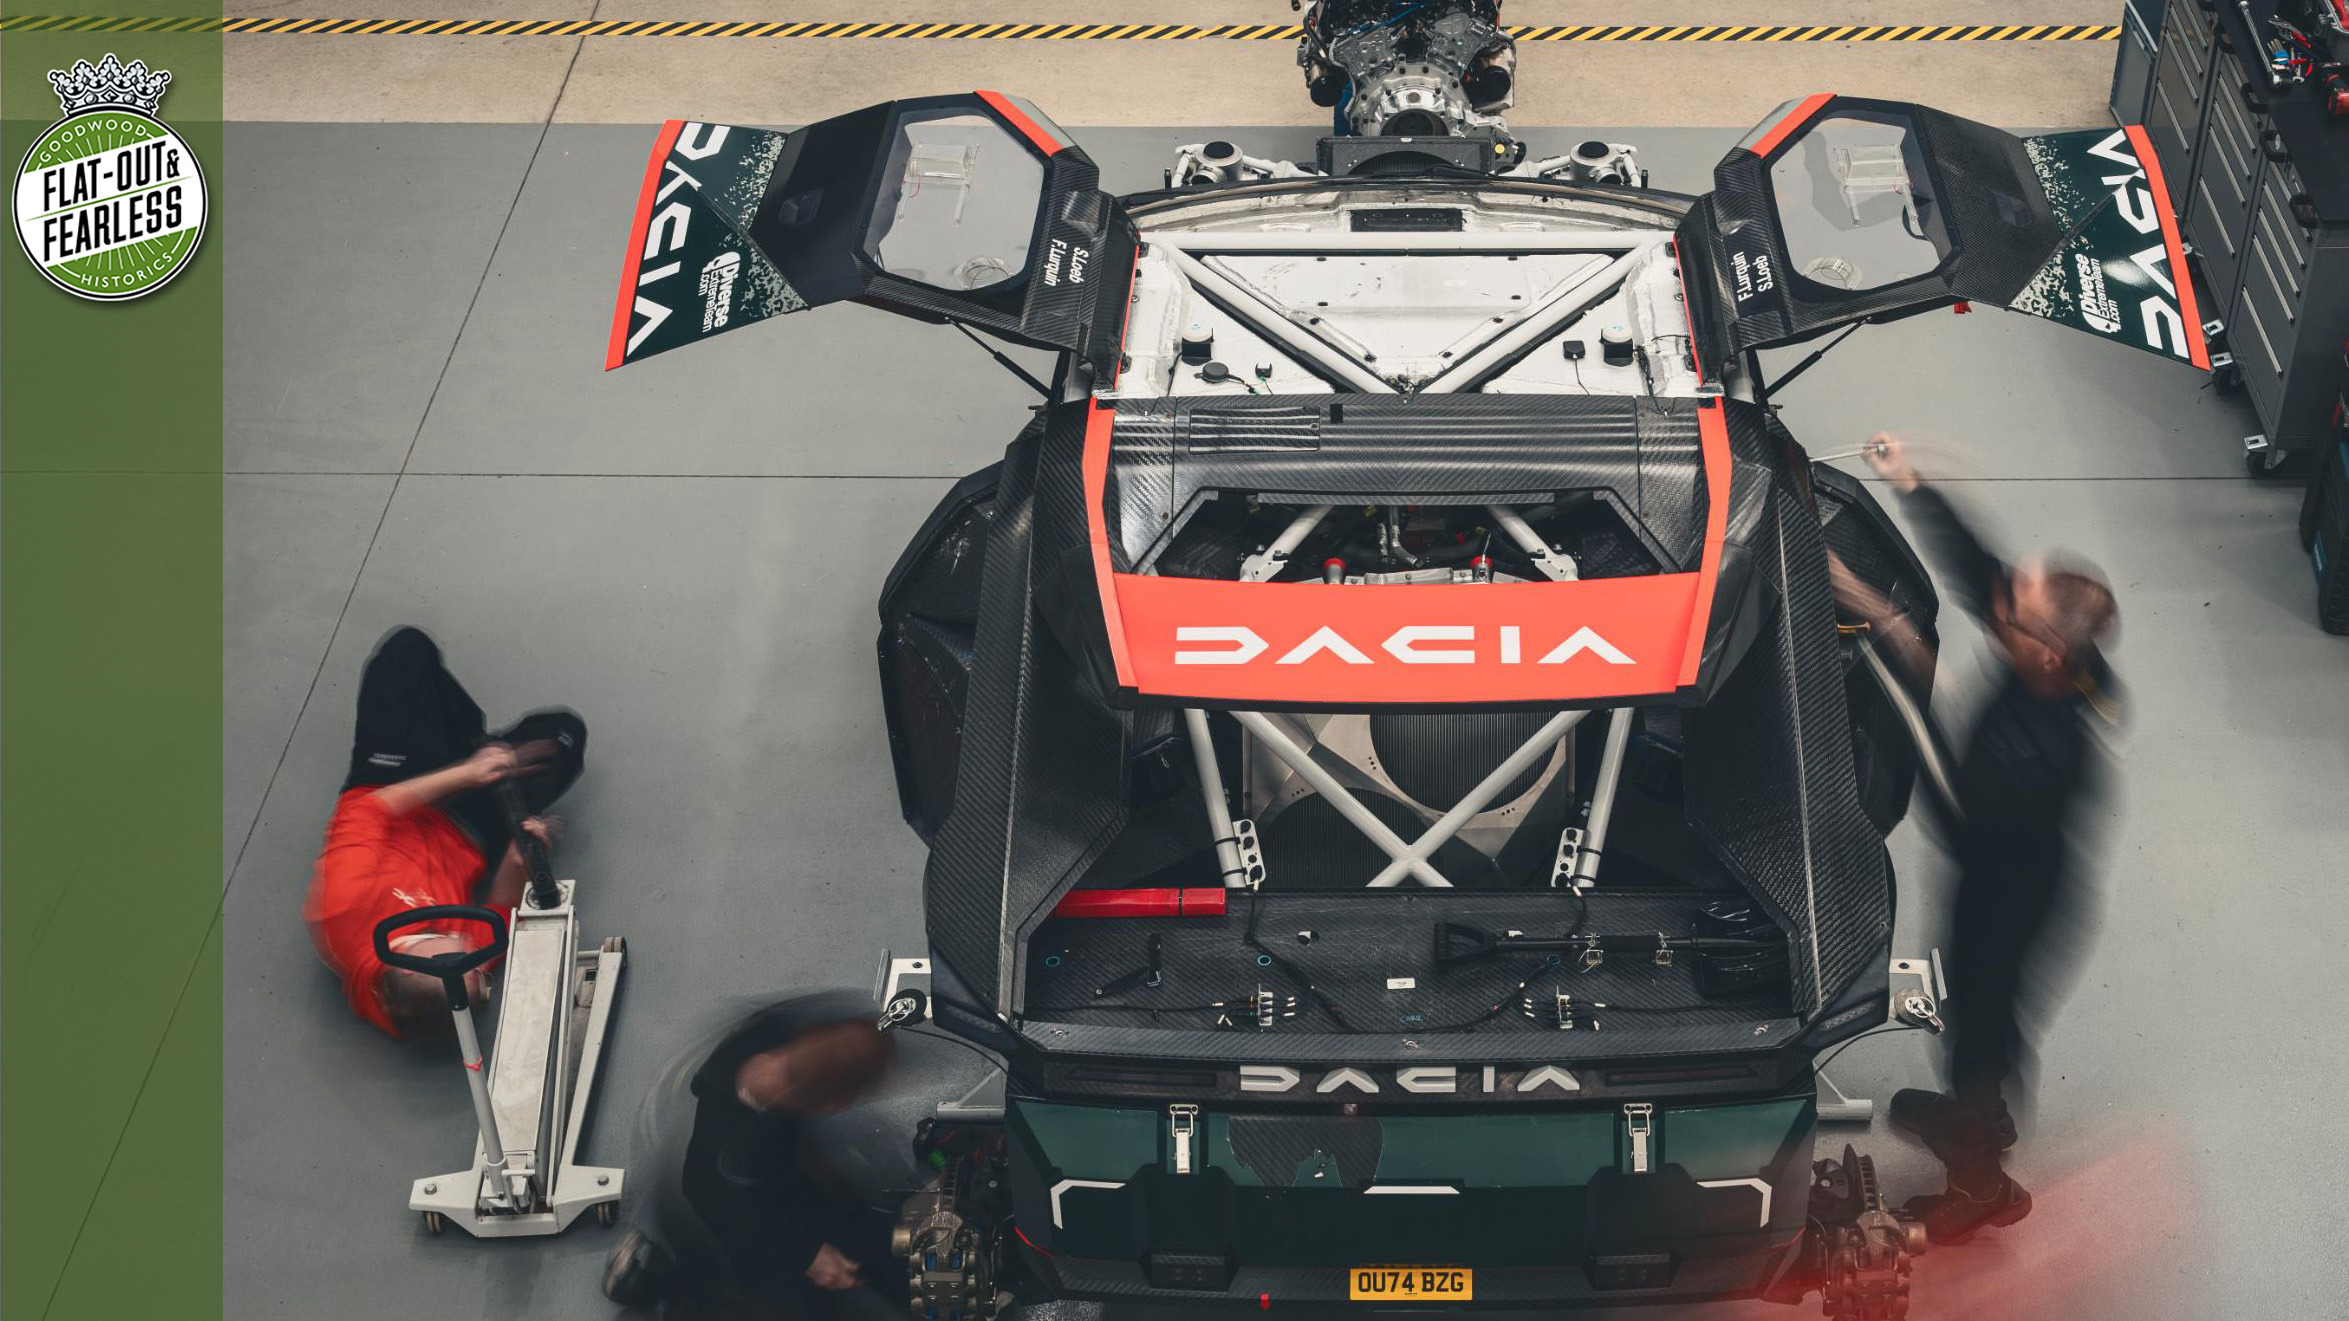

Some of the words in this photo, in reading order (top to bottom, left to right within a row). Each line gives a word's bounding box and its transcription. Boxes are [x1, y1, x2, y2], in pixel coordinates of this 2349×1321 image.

[1044, 238, 1067, 287] F.Lurquin
[1069, 246, 1089, 284] S.Loeb
[1730, 251, 1753, 302] F.Lurquin
[1752, 255, 1773, 292] S.Loeb
[713, 261, 741, 328] Diverse
[2075, 253, 2101, 317] Diverse
[1174, 625, 1637, 665] DACIA
[1239, 1065, 1581, 1093] DACIA
[1358, 1271, 1415, 1293] OU74
[1421, 1271, 1464, 1293] BZG
